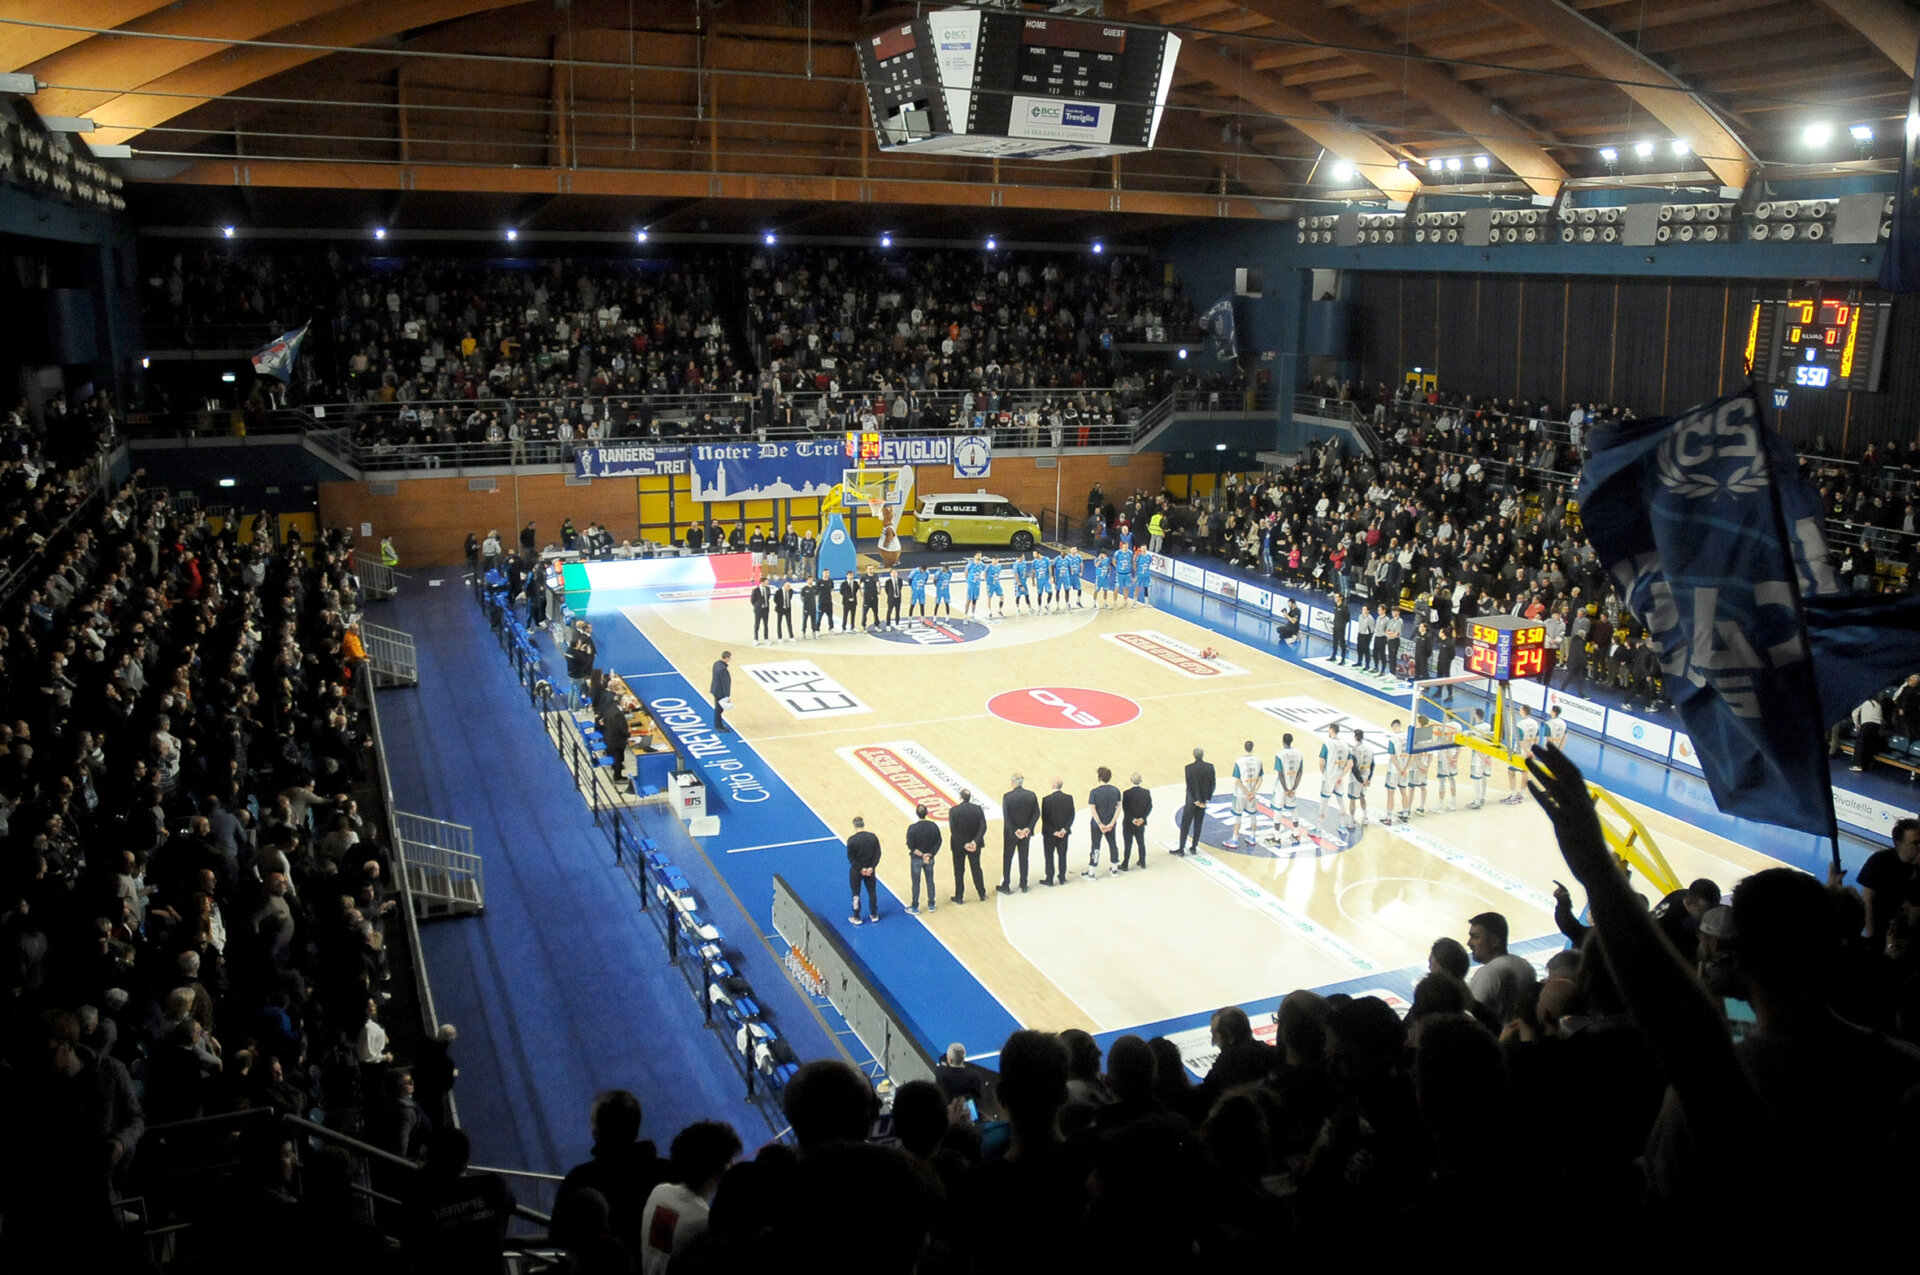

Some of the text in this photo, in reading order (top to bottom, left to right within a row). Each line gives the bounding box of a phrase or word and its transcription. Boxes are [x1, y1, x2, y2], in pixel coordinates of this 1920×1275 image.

[1026, 20, 1046, 30] HOME
[1103, 28, 1125, 37] GUEST
[1022, 74, 1037, 82] FOULS
[1041, 107, 1060, 115] BCC
[1065, 113, 1095, 123] Treviglio
[1802, 305, 1813, 324] 0
[1837, 306, 1849, 325] 0
[1791, 329, 1802, 343] 0
[1825, 330, 1836, 345] 0
[1775, 395, 1788, 407] W
[598, 448, 655, 463] RANGERS
[697, 445, 751, 460] Noter
[757, 443, 789, 459] De
[862, 444, 879, 457] 24
[879, 440, 947, 459] EVIGLIO
[1471, 645, 1498, 676] 24
[1515, 648, 1542, 676] 24
[650, 698, 770, 803] Città di TREVIGLIO
[859, 749, 906, 776] WEST
[1833, 793, 1872, 814] Rivoltella
